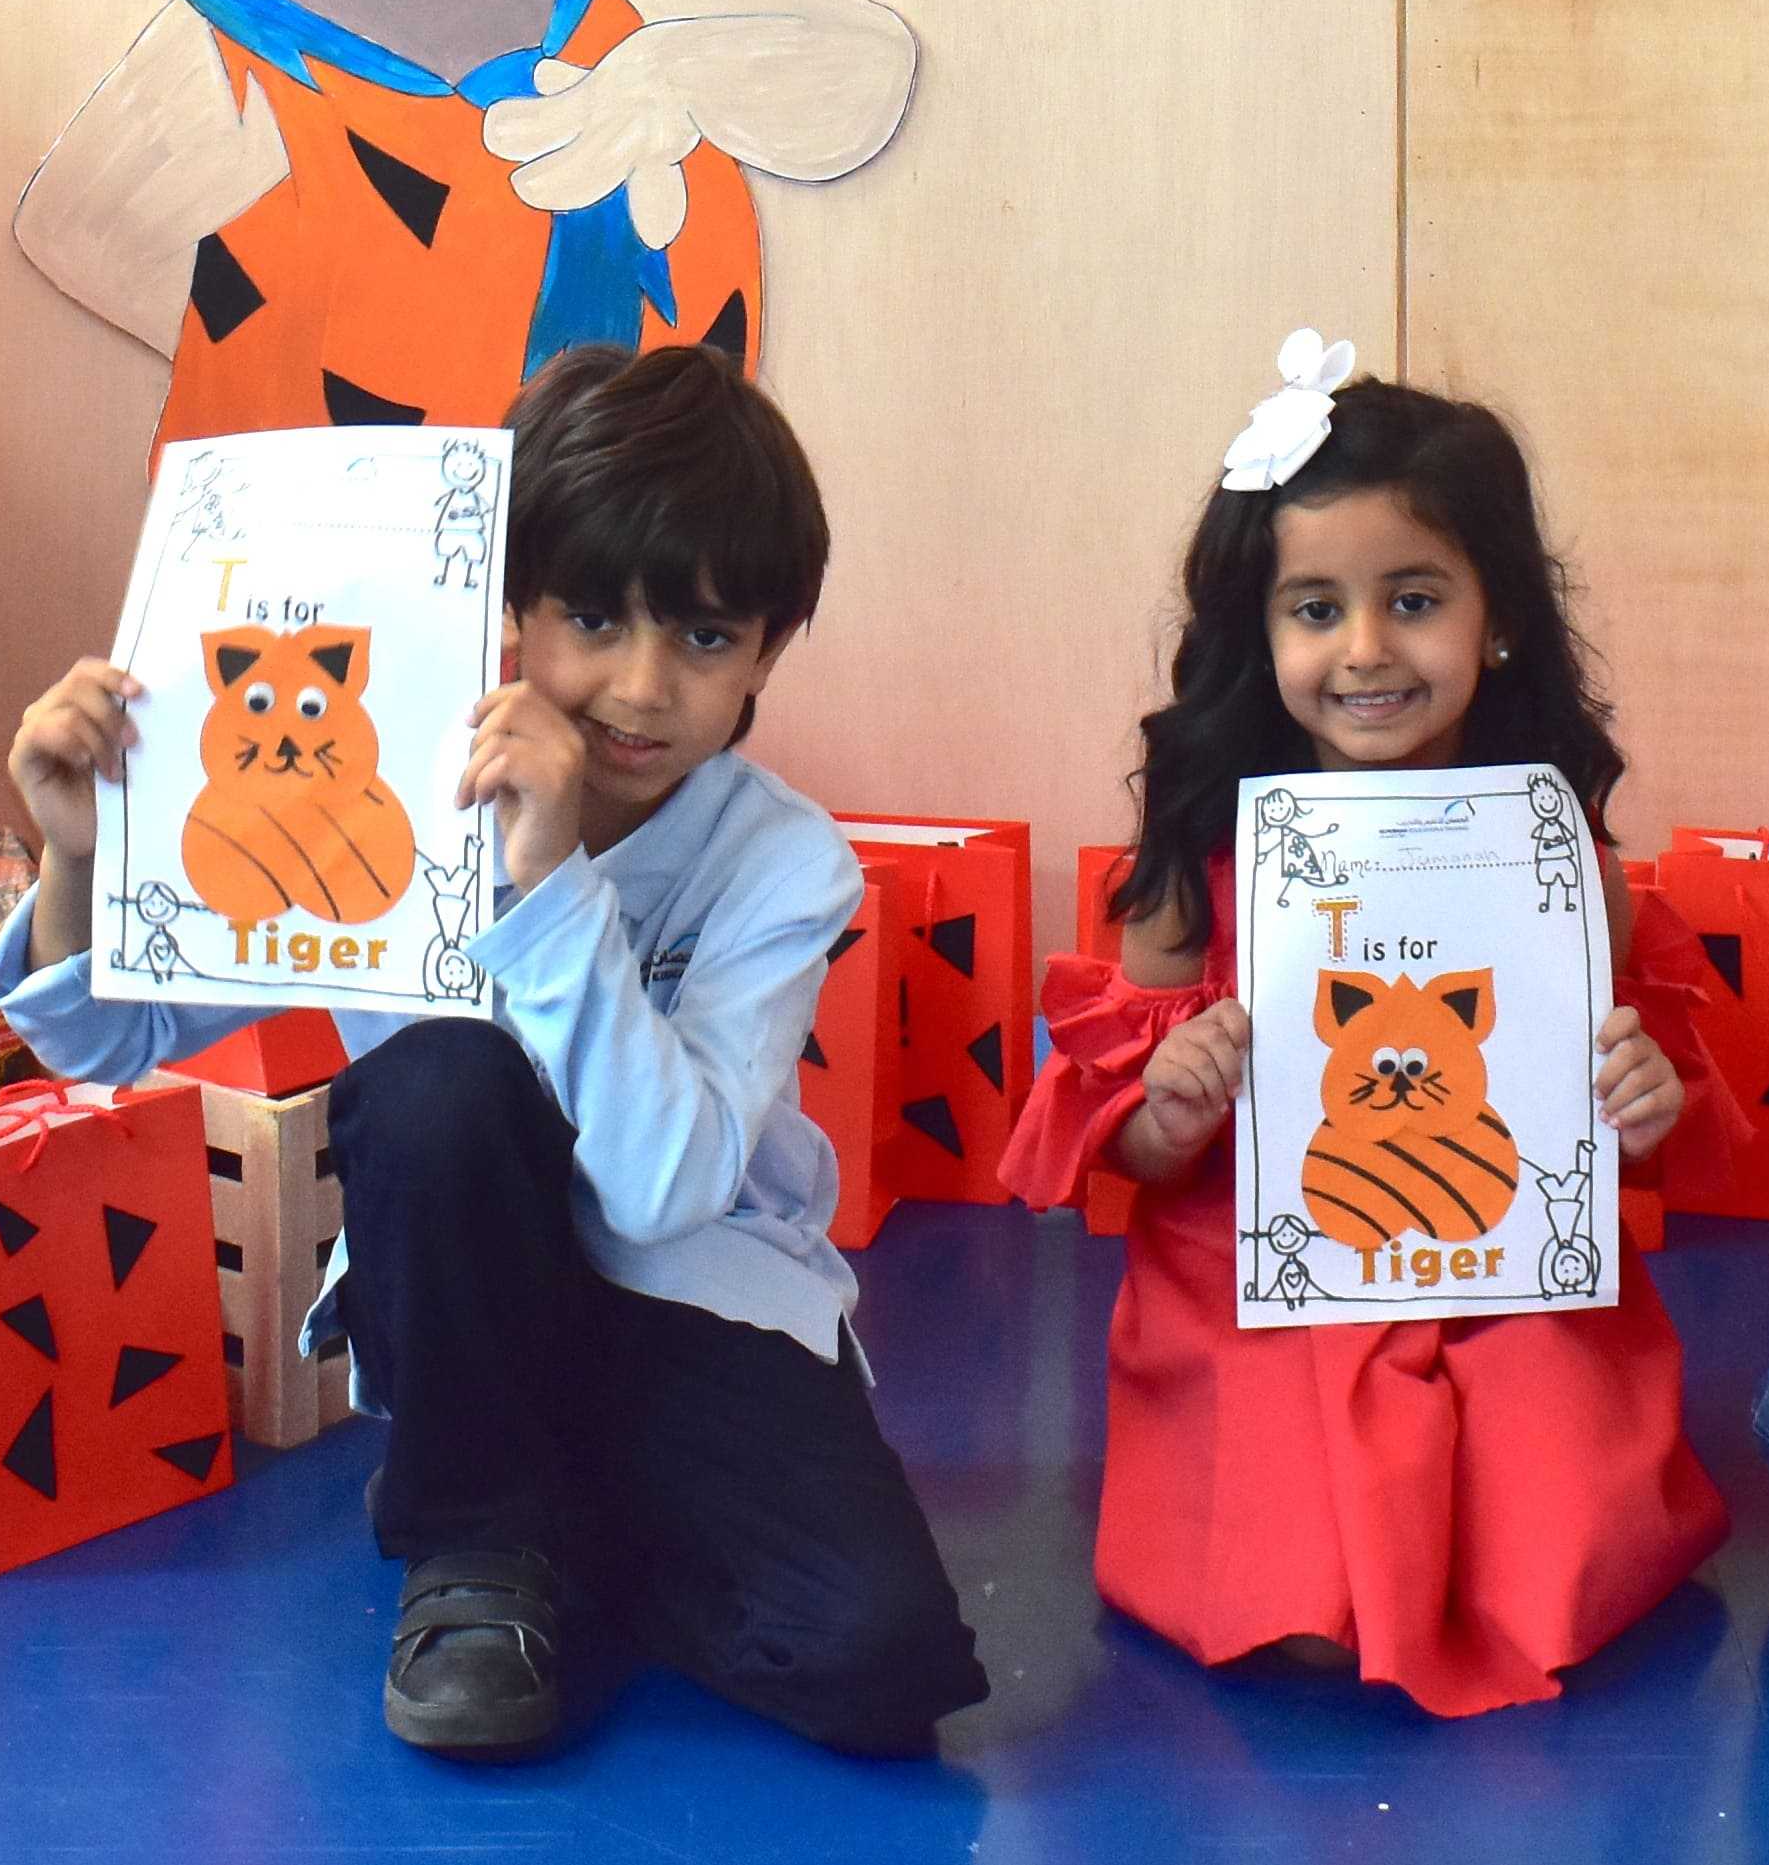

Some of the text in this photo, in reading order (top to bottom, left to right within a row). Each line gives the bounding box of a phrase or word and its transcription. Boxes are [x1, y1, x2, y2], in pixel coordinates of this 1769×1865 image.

[212, 557, 325, 623] T is for
[226, 917, 388, 975] Tiger
[1312, 895, 1438, 962] T is for
[1354, 1238, 1506, 1288] Tiger
